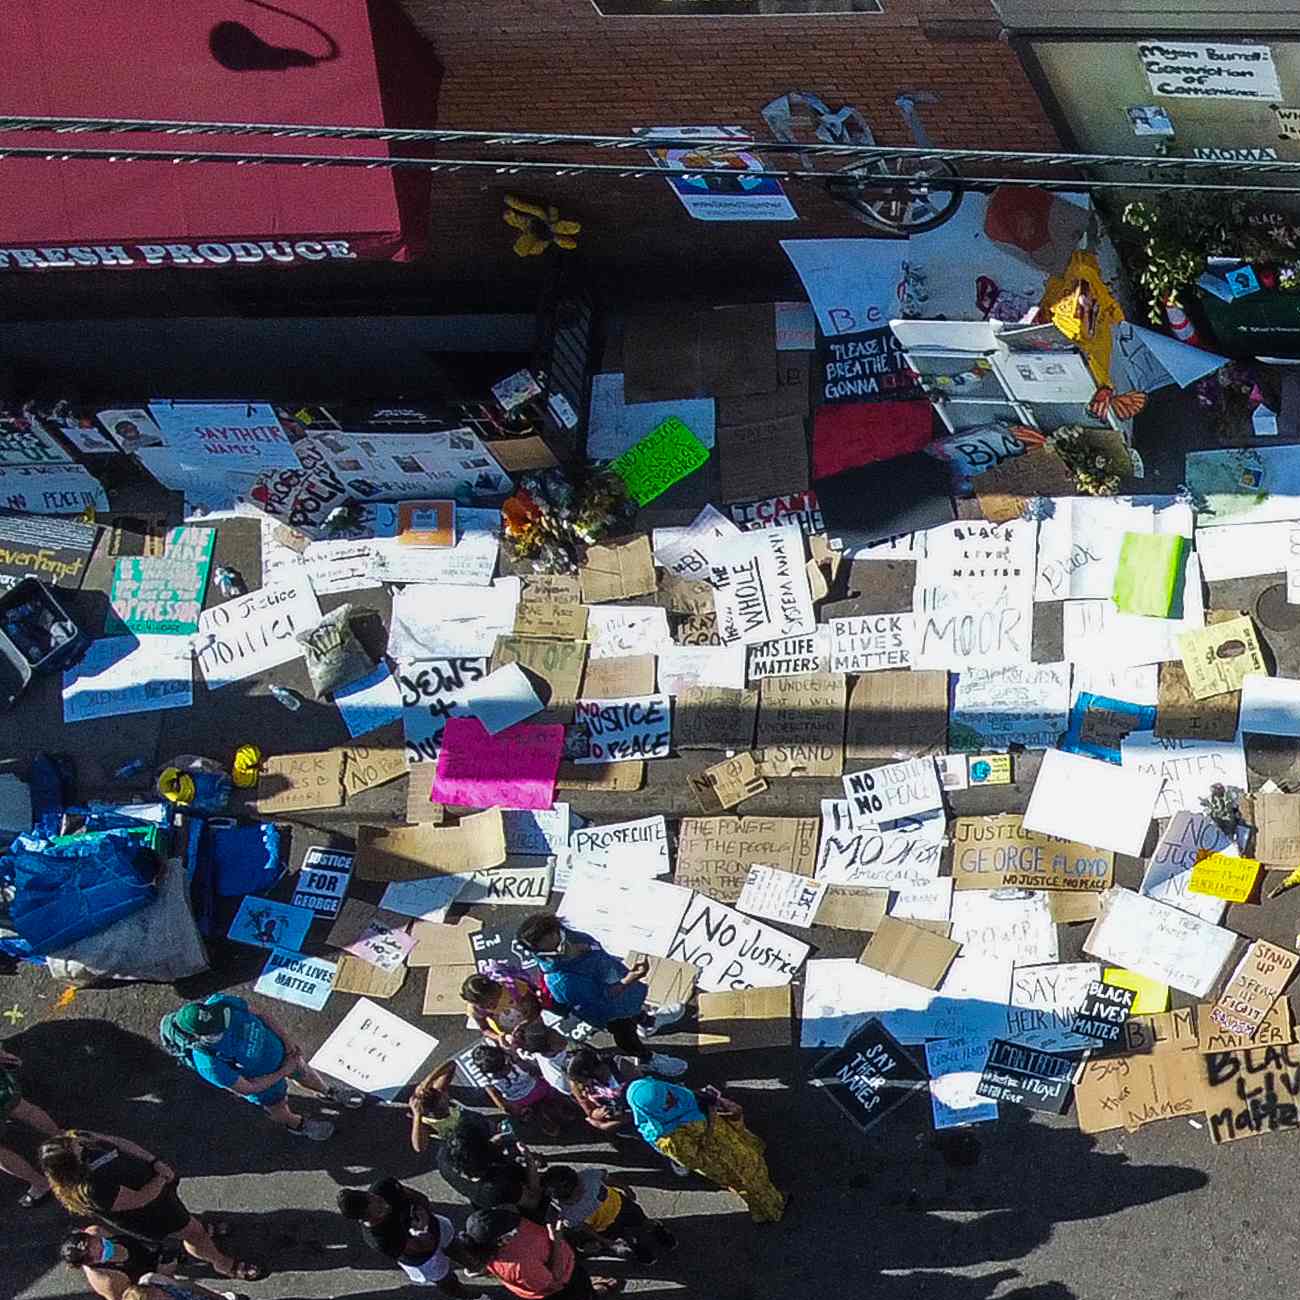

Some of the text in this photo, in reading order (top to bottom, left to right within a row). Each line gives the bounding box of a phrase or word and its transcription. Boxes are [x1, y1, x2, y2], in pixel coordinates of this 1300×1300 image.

[733, 561, 764, 632] WHOLE
[835, 617, 902, 634] BLACK
[838, 636, 903, 652] LIVES
[754, 656, 819, 676] MATTERS
[834, 650, 910, 669] MATTER
[400, 658, 483, 706] JEWS
[851, 774, 875, 793] NO
[856, 793, 882, 814] NO
[960, 847, 1109, 876] GEORGE FLOYD
[308, 871, 339, 892] FOR
[487, 874, 550, 898] KROLL
[1255, 945, 1292, 969] STAND
[1256, 962, 1275, 975] UP
[1016, 975, 1061, 1003] SAY
[1089, 981, 1132, 1005] BLACK
[1080, 997, 1129, 1023] LIVES
[1071, 1018, 1121, 1040] MATTER
[866, 1044, 895, 1071] SAY
